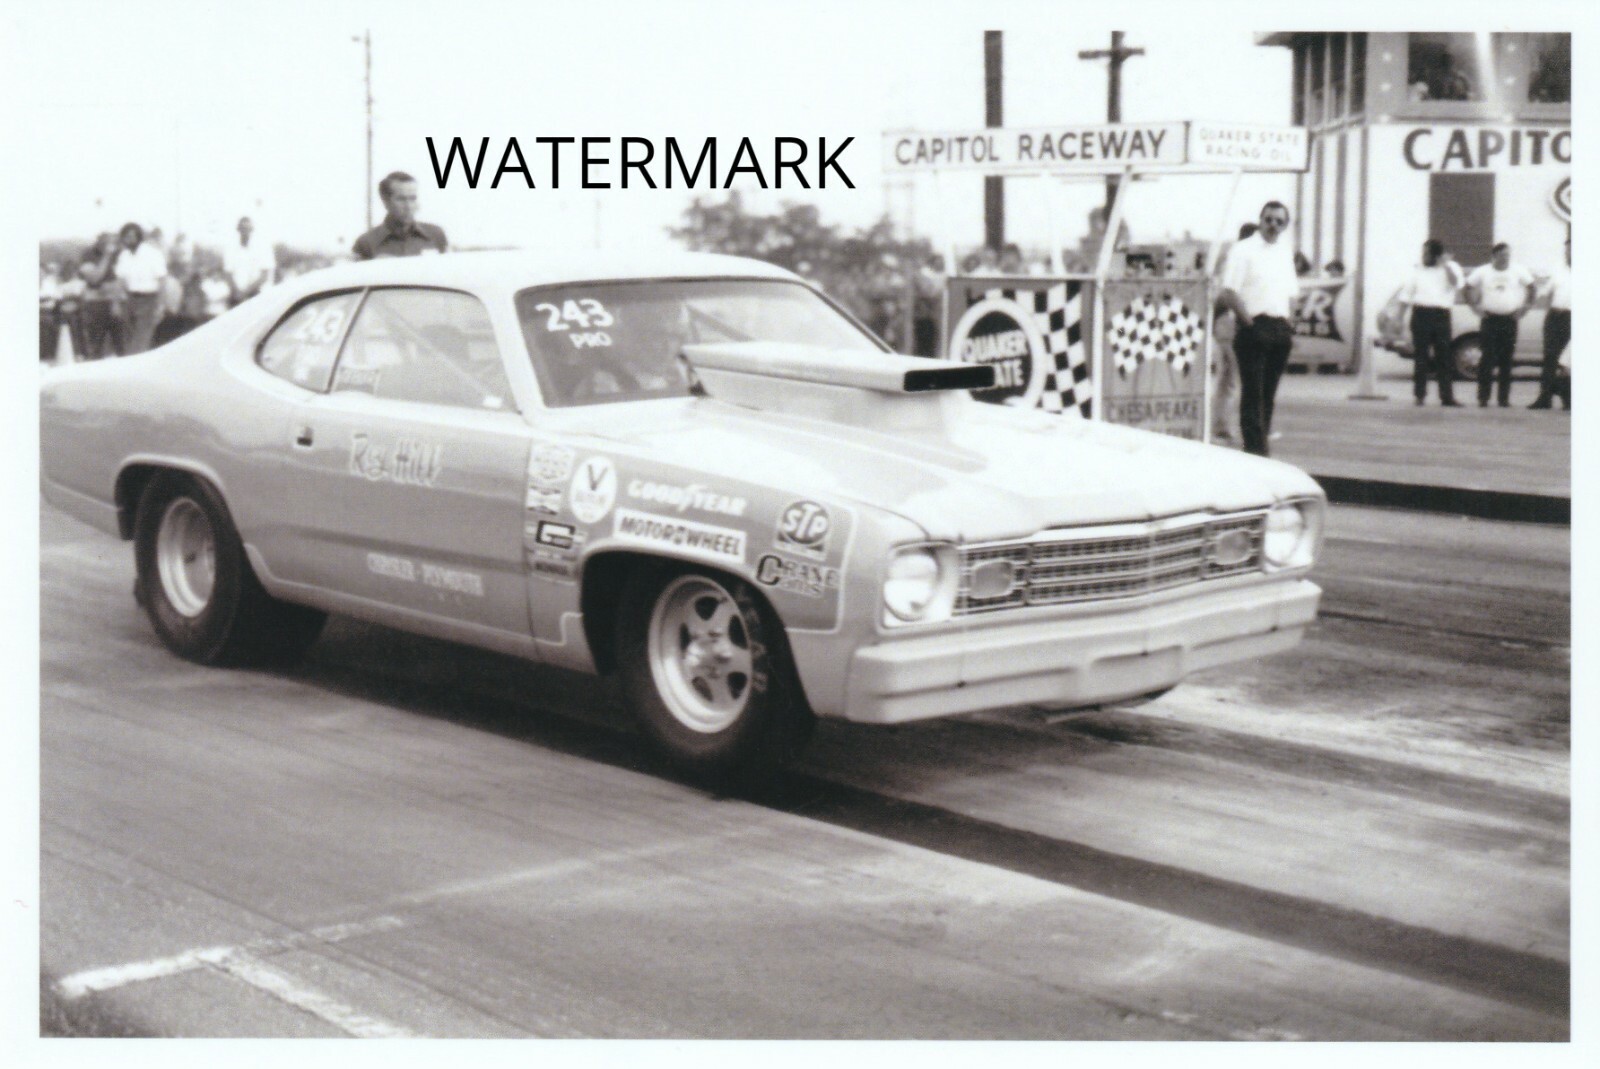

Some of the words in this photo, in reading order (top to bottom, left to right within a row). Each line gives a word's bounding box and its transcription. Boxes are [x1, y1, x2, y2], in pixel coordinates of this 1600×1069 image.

[895, 134, 999, 166] CAPITOL
[1018, 128, 1167, 161] RACEWAY
[1199, 127, 1251, 142] QUAKER
[1259, 131, 1299, 146] STATE
[1206, 144, 1261, 159] RACING
[1270, 148, 1291, 161] OIL
[294, 307, 345, 343] 243
[535, 299, 614, 332] 243
[569, 332, 612, 350] PRO
[961, 329, 1028, 362] QUAKER
[587, 463, 609, 491] V
[782, 503, 828, 539] STP
